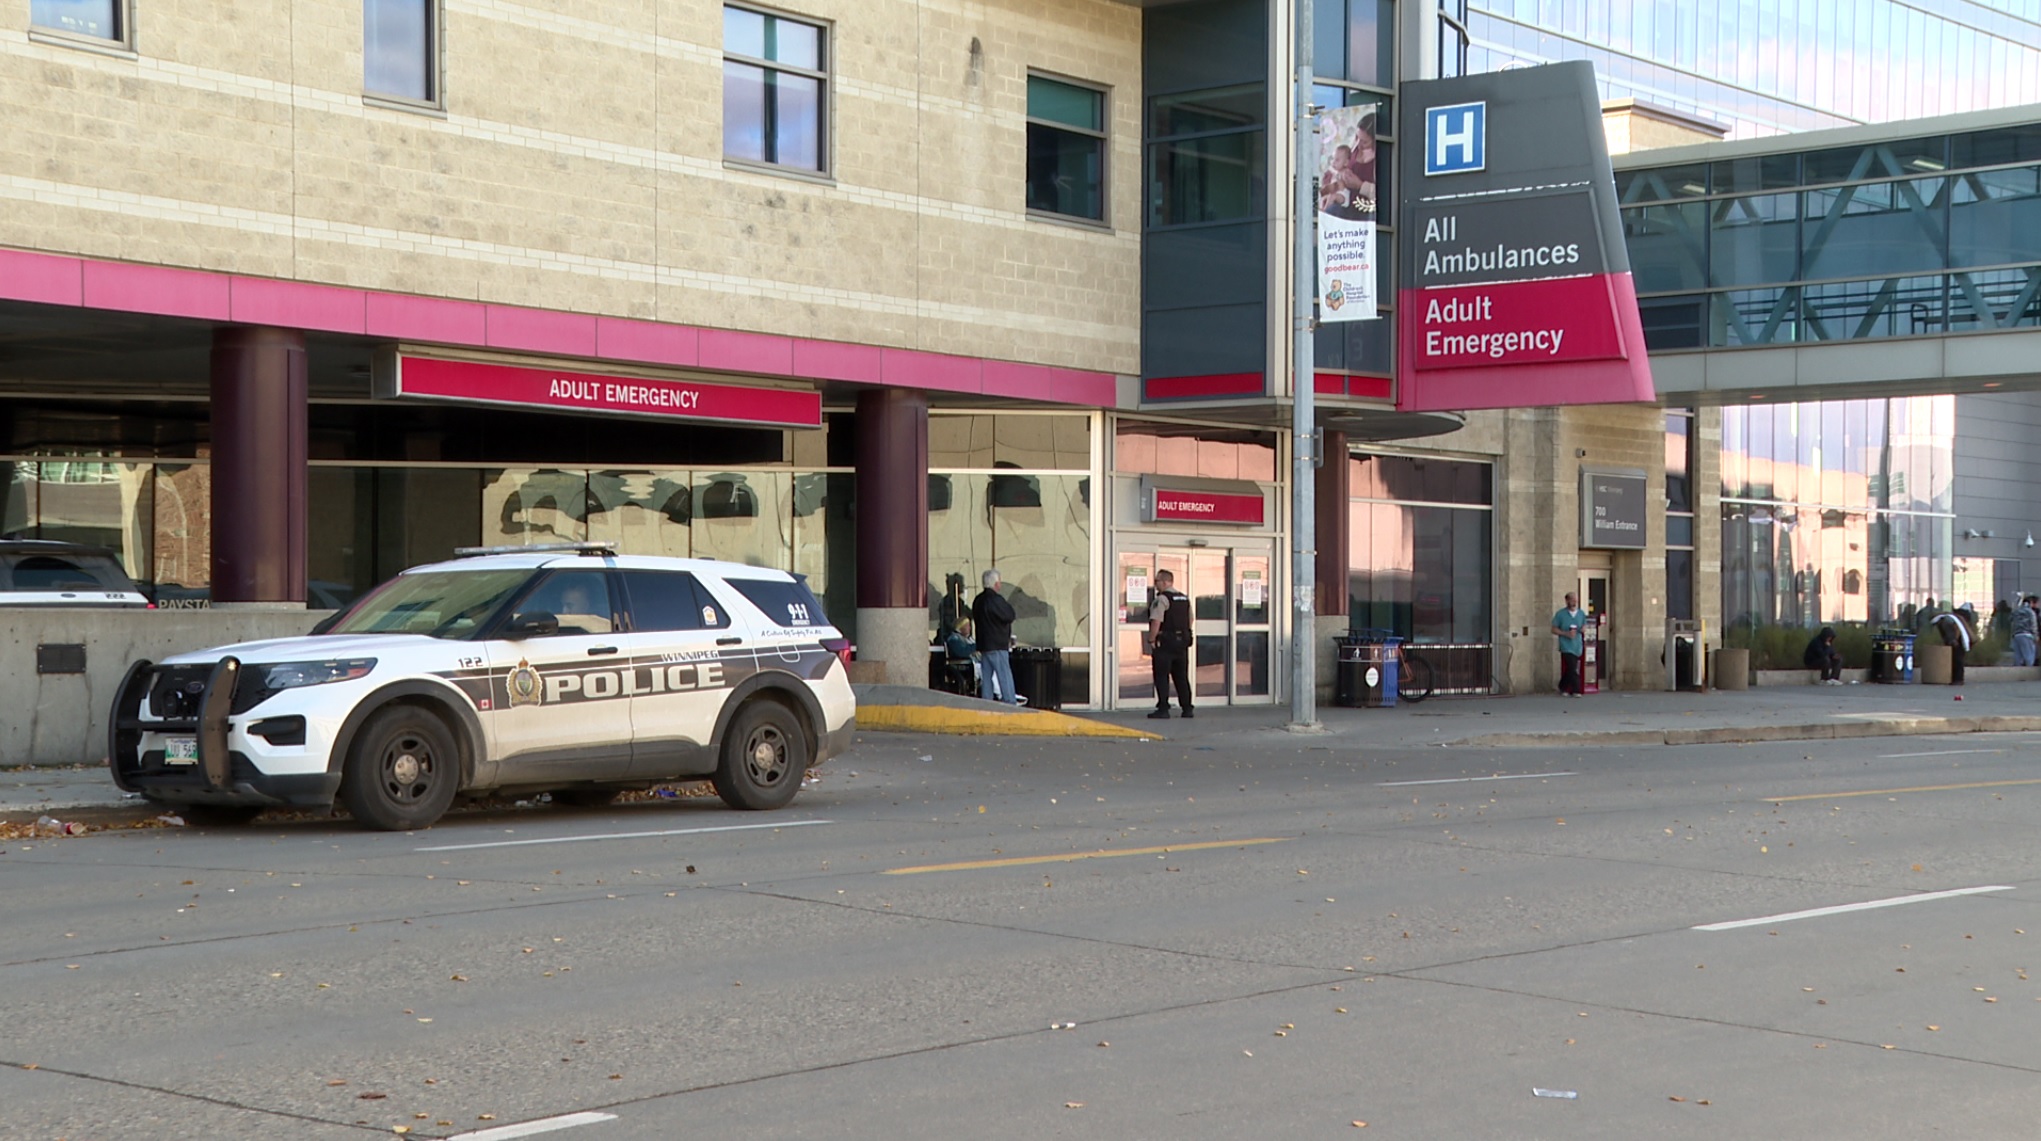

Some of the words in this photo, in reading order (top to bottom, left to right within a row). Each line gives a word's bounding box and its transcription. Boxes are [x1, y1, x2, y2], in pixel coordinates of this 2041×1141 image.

[1436, 111, 1474, 166] H
[1324, 229, 1344, 240] Let's
[1345, 227, 1369, 238] make
[1423, 215, 1456, 244] All
[1327, 240, 1366, 251] anything
[1423, 243, 1579, 276] Ambulances
[1324, 263, 1369, 275] goodbear.ca
[1424, 295, 1492, 325] Adult
[1425, 328, 1564, 358] Emergency
[549, 379, 601, 401] ADULT
[605, 384, 699, 408] EMERGENCY
[1158, 500, 1178, 511] ADULT
[1178, 501, 1215, 513] EMERGENCY
[1595, 505, 1606, 517] 700
[1595, 519, 1614, 529] William
[1615, 520, 1638, 531] Entrance
[457, 656, 483, 668] 122
[661, 650, 719, 663] WINNIPEG
[545, 662, 725, 702] POLICE
